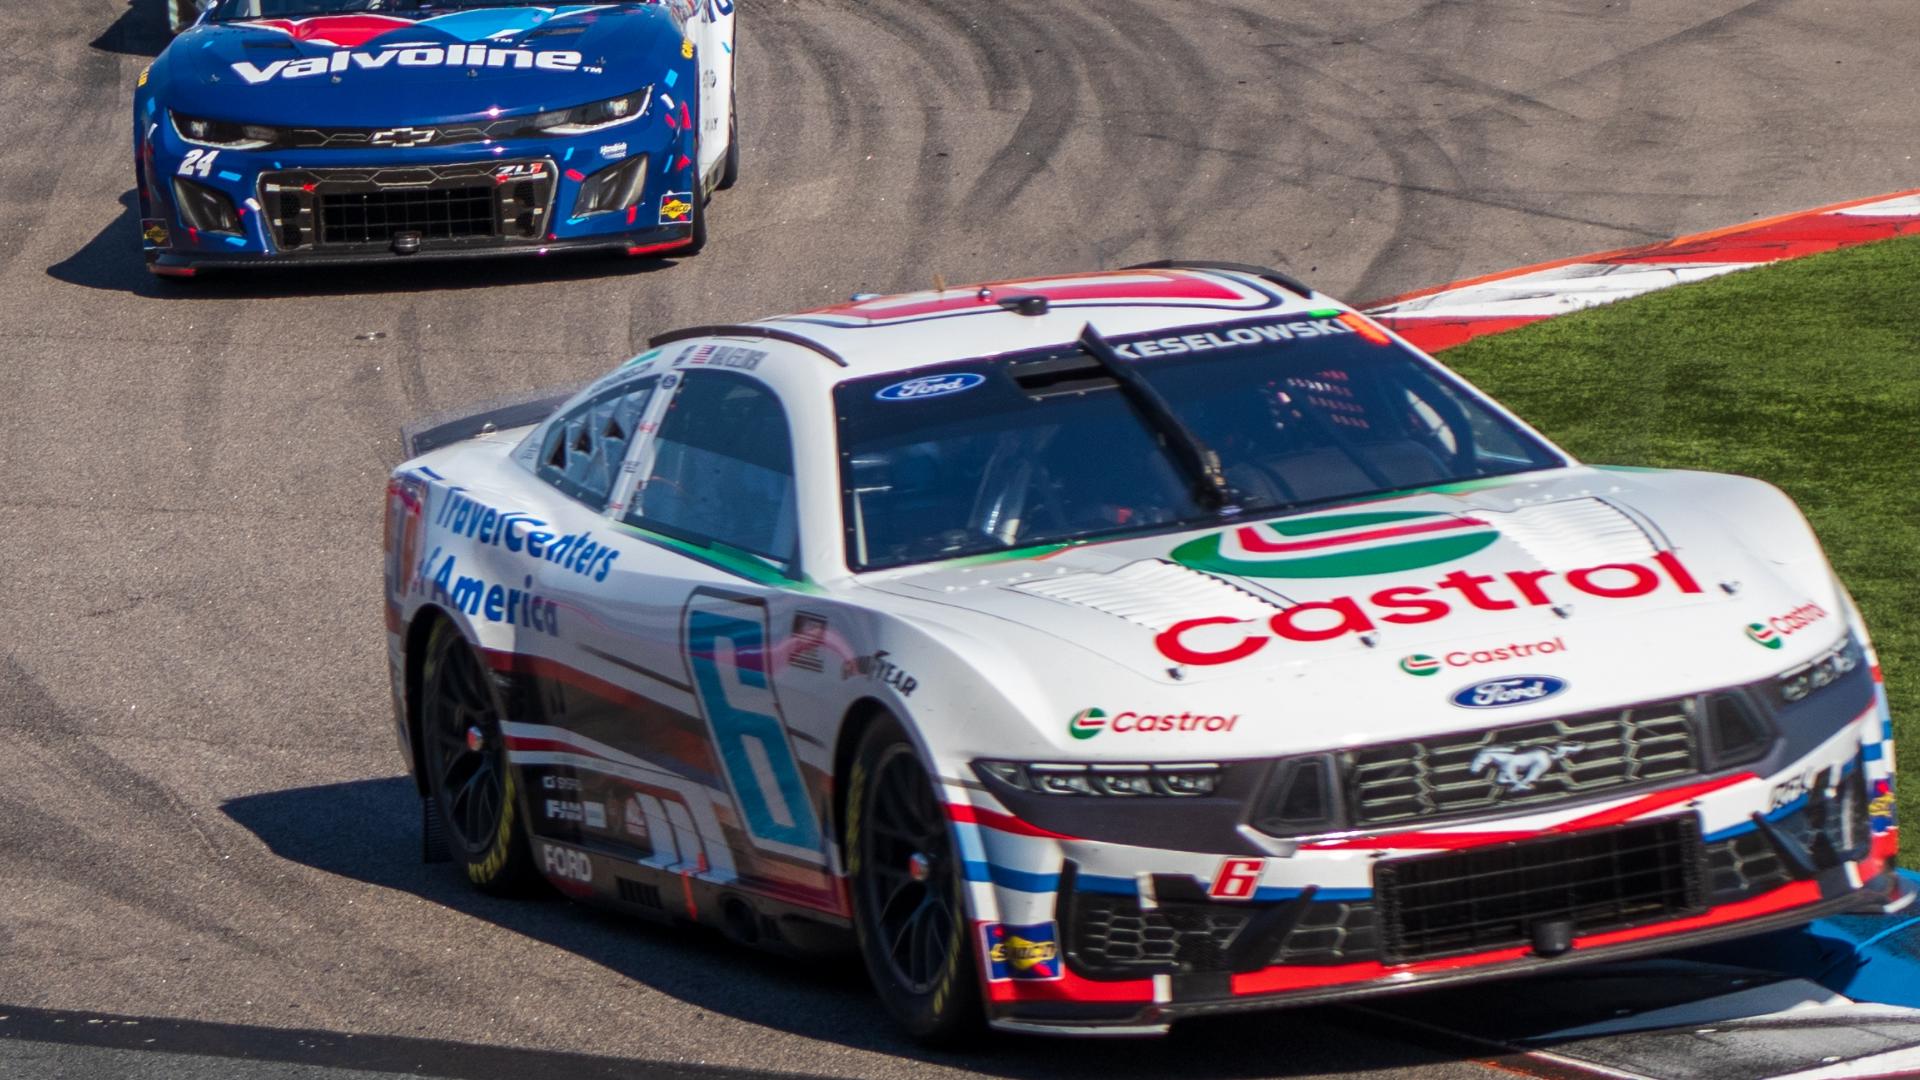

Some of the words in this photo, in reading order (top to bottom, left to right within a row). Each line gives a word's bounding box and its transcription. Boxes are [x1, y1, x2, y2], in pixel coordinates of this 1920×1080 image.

[177, 149, 220, 177] 24
[1444, 632, 1567, 668] Castrol
[1472, 678, 1548, 706] Ford
[688, 609, 823, 855] 6
[1110, 711, 1242, 733] Castrol
[543, 844, 592, 882] FORD
[1210, 859, 1265, 898] 6
